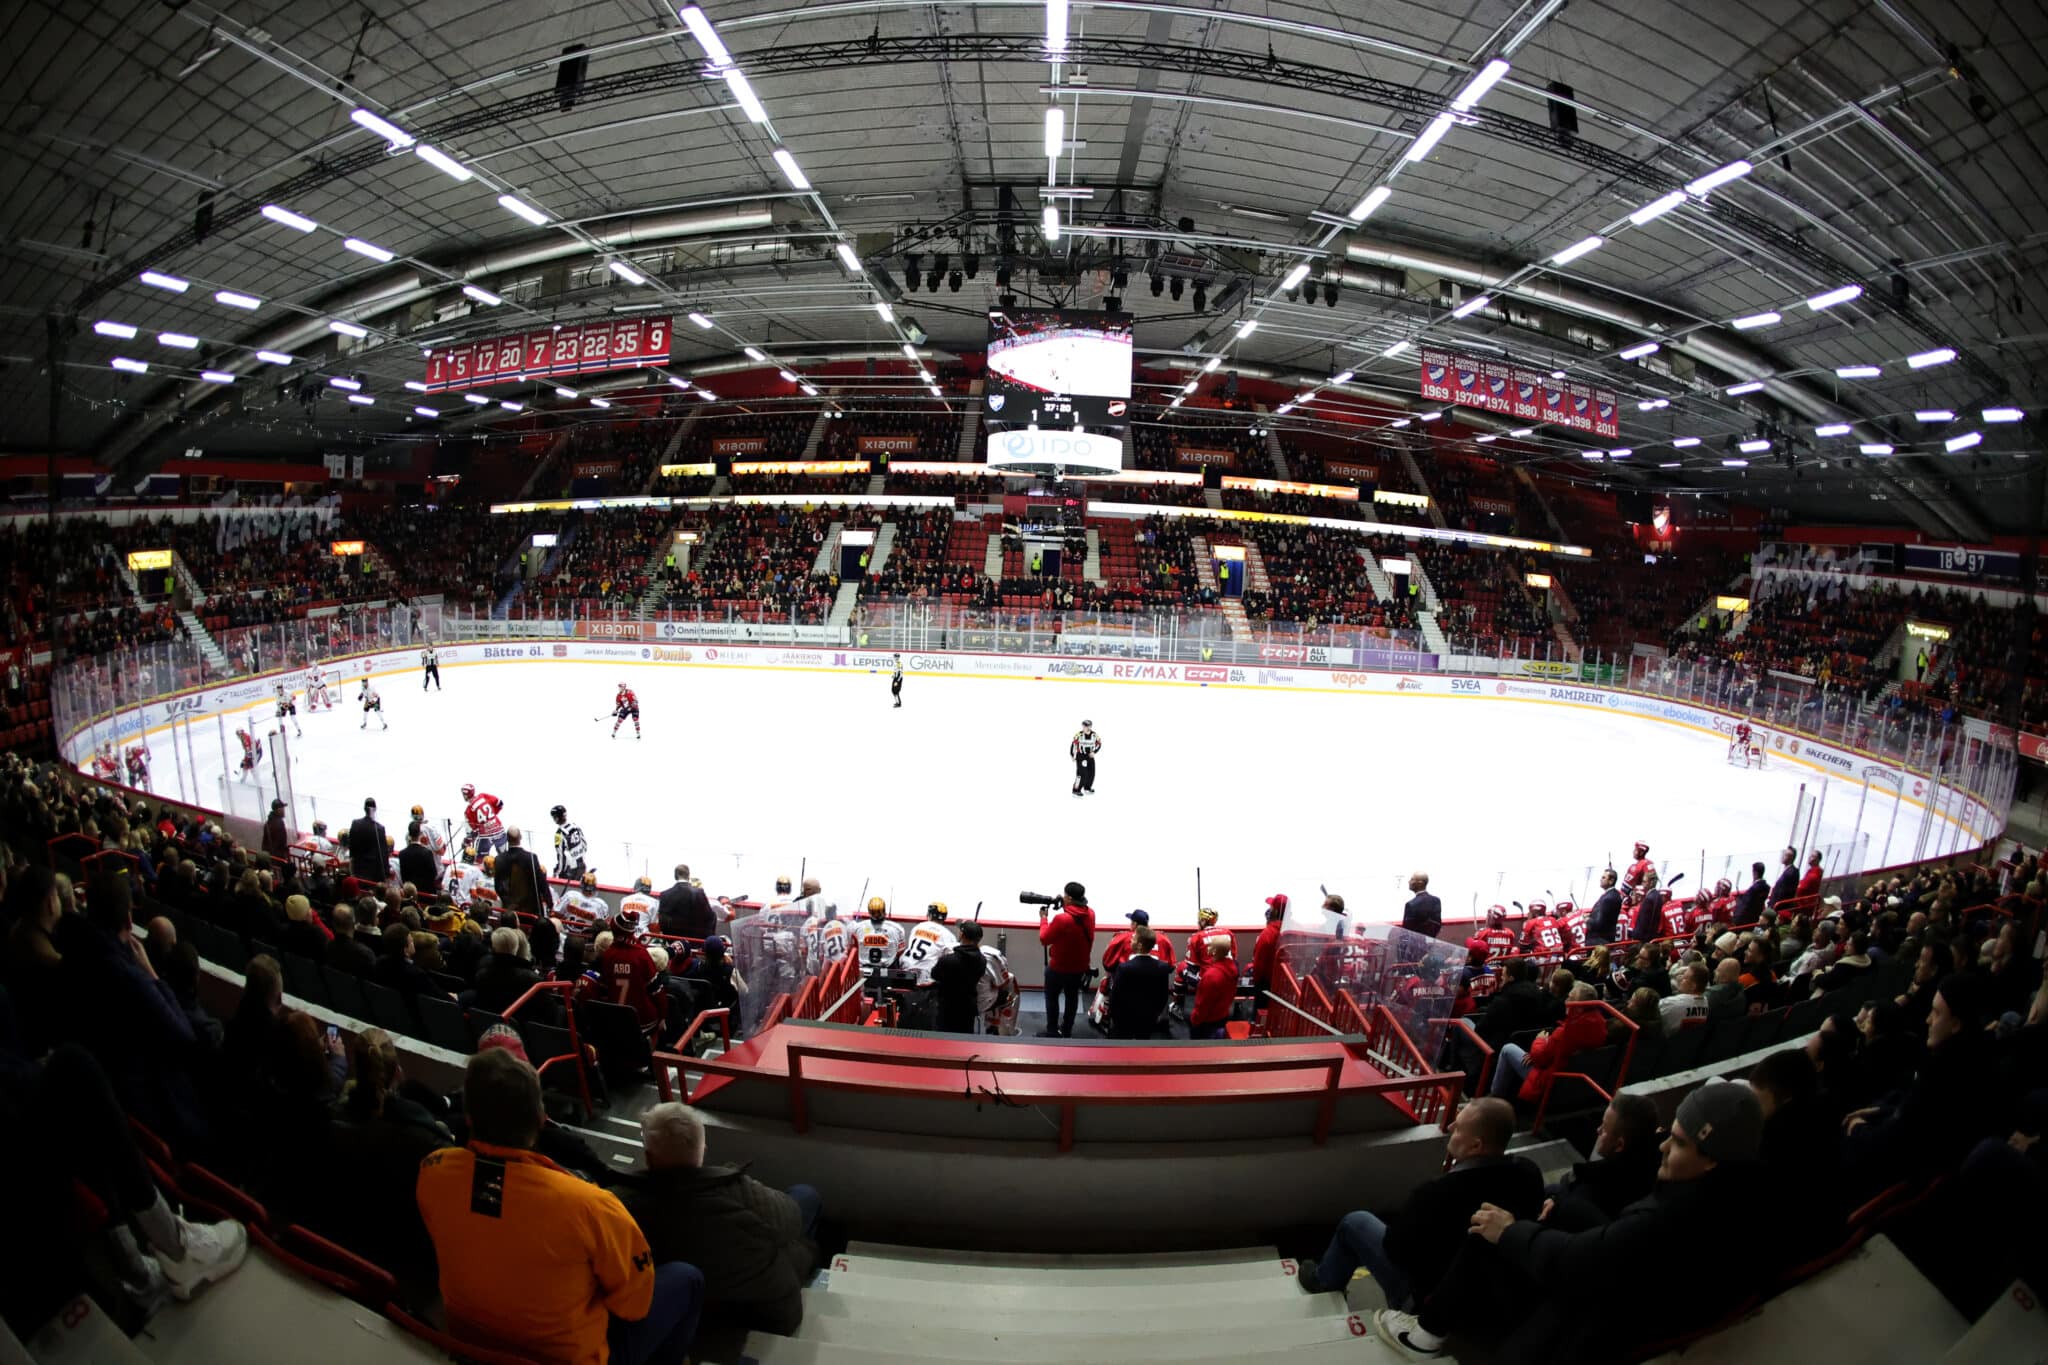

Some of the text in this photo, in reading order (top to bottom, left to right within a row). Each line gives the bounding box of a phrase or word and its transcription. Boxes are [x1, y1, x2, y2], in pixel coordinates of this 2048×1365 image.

[434, 330, 663, 379] 1 5 17 20 7 23 22 35 9
[1424, 384, 1448, 399] 1969
[1455, 390, 1480, 405] 1970
[1486, 397, 1510, 412] 1974
[1514, 403, 1538, 417] 1980
[1032, 410, 1038, 421] 1
[1073, 412, 1079, 423] 1
[1543, 408, 1564, 422] 1983
[1570, 415, 1590, 430] 1998
[1596, 422, 1616, 436] 2011
[719, 440, 762, 452] xiaomi
[865, 440, 913, 450] xiaomi
[1181, 452, 1230, 464] xiaomi
[578, 464, 616, 476] xiaomi
[1330, 464, 1374, 479] xiaomi
[1940, 552, 1953, 569] 18
[592, 624, 641, 634] xiaomi
[484, 648, 524, 658] Bättre
[1310, 648, 1325, 656] ALL
[910, 656, 954, 670] GRAHN
[1114, 664, 1178, 680] RE/MAX
[1186, 669, 1226, 680] CCM
[1230, 668, 1244, 676] ALL
[1332, 672, 1368, 688] vepe
[1452, 680, 1480, 691] SVEA
[1550, 688, 1605, 704] RAMIRENT
[1664, 708, 1708, 726] ebookers
[1805, 747, 1853, 772] SKECHERS
[477, 803, 495, 824] 42
[1541, 928, 1562, 948] 63
[826, 935, 845, 957] 21
[904, 938, 932, 960] 15
[614, 964, 631, 974] ARO
[616, 979, 630, 1004] 7
[834, 1258, 849, 1272] 5
[1281, 1260, 1296, 1276] 5
[1346, 1315, 1367, 1337] 6
